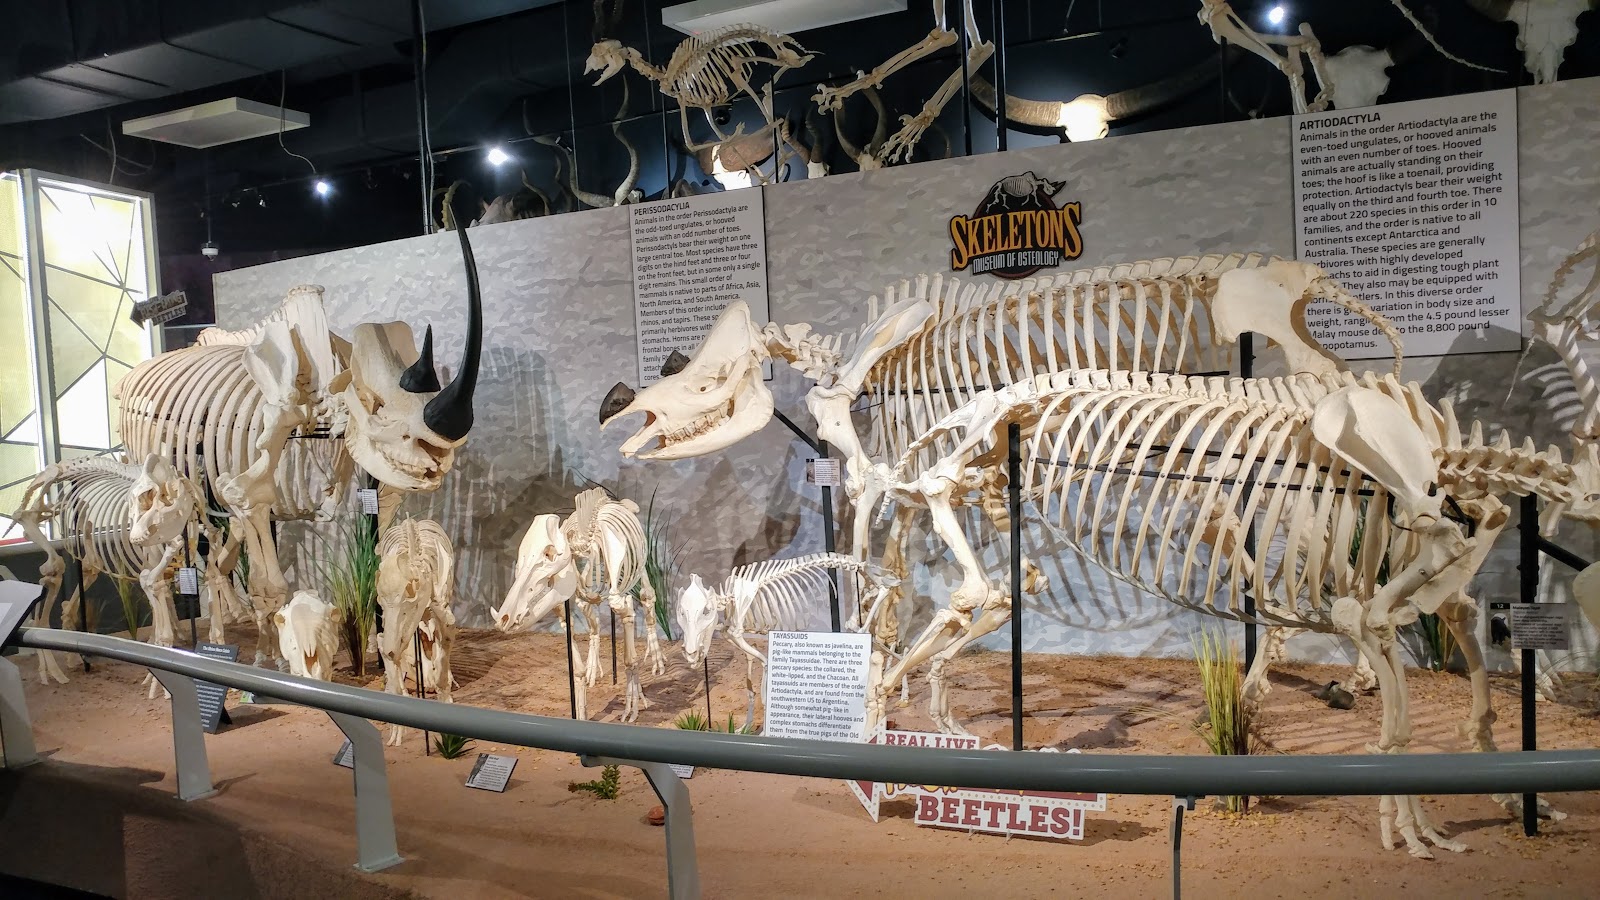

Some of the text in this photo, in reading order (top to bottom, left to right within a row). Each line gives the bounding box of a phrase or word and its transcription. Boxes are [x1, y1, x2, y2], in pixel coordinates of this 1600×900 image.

[1300, 113, 1381, 131] ARTIODACTYLA
[1300, 131, 1337, 142] Animals
[1351, 128, 1367, 136] the
[1369, 125, 1395, 134] order
[1398, 116, 1458, 131] Artiodactyla
[1480, 112, 1497, 121] the
[1301, 141, 1348, 154] even-toed
[1351, 137, 1401, 149] ungulates,
[1417, 128, 1453, 140] hooved
[1456, 124, 1496, 136] animals
[1301, 156, 1321, 165] with
[1363, 148, 1400, 159] number
[1403, 145, 1413, 154] of
[1416, 145, 1440, 153] toes.
[1443, 137, 1481, 150] Hooved
[1302, 166, 1338, 177] animals
[1358, 160, 1395, 171] actually
[1398, 156, 1441, 167] standing
[1459, 150, 1483, 160] their
[1327, 178, 1342, 186] the
[1345, 174, 1366, 184] hoof
[1380, 172, 1396, 181] like
[1407, 166, 1443, 178] toenail,
[1447, 162, 1494, 176] providing
[1303, 173, 1502, 202] protection. Artiodactyls bear their weight
[1303, 202, 1336, 213] equally
[1353, 199, 1368, 207] the
[1371, 196, 1393, 205] third
[1396, 193, 1414, 203] and
[1417, 190, 1448, 201] fourth
[1472, 186, 1502, 195] There
[1321, 212, 1347, 222] about
[1350, 210, 1368, 219] 220
[1371, 207, 1406, 219] species
[1420, 204, 1439, 212] this
[1442, 201, 1469, 210] order
[1484, 198, 1497, 206] 10
[635, 217, 658, 225] Animals
[694, 206, 737, 217] Perissodactyla
[646, 224, 672, 233] odd-toed
[674, 221, 704, 231] ungulates,
[713, 216, 735, 224] hooved
[1304, 225, 1343, 235] families,
[1346, 222, 1363, 232] and
[1365, 221, 1381, 230] the
[1384, 219, 1409, 228] order
[1423, 215, 1453, 224] native
[1469, 211, 1480, 220] all
[636, 235, 658, 244] animals
[695, 228, 718, 236] number
[636, 242, 678, 253] Perissodactyls
[708, 236, 729, 245] weight
[951, 203, 1081, 268] SKELETONS
[1305, 226, 1460, 246] continents except Antarctica and
[653, 252, 672, 260] central
[702, 247, 724, 256] species
[1305, 248, 1348, 258] Australia.
[1351, 246, 1379, 254] These
[1382, 242, 1417, 254] species
[1439, 236, 1485, 250] generally
[974, 250, 1058, 273] MUSEUM OF OSTEOLOGY
[1317, 250, 1463, 269] rbivores with highly developed
[1365, 268, 1379, 277] aid
[1393, 265, 1438, 276] digesting
[1441, 261, 1470, 272] tough
[1473, 260, 1499, 271] plant
[1322, 341, 1377, 352] popotamus.
[885, 734, 976, 749] REAL LIVE
[918, 795, 1081, 836] BEETLES!
